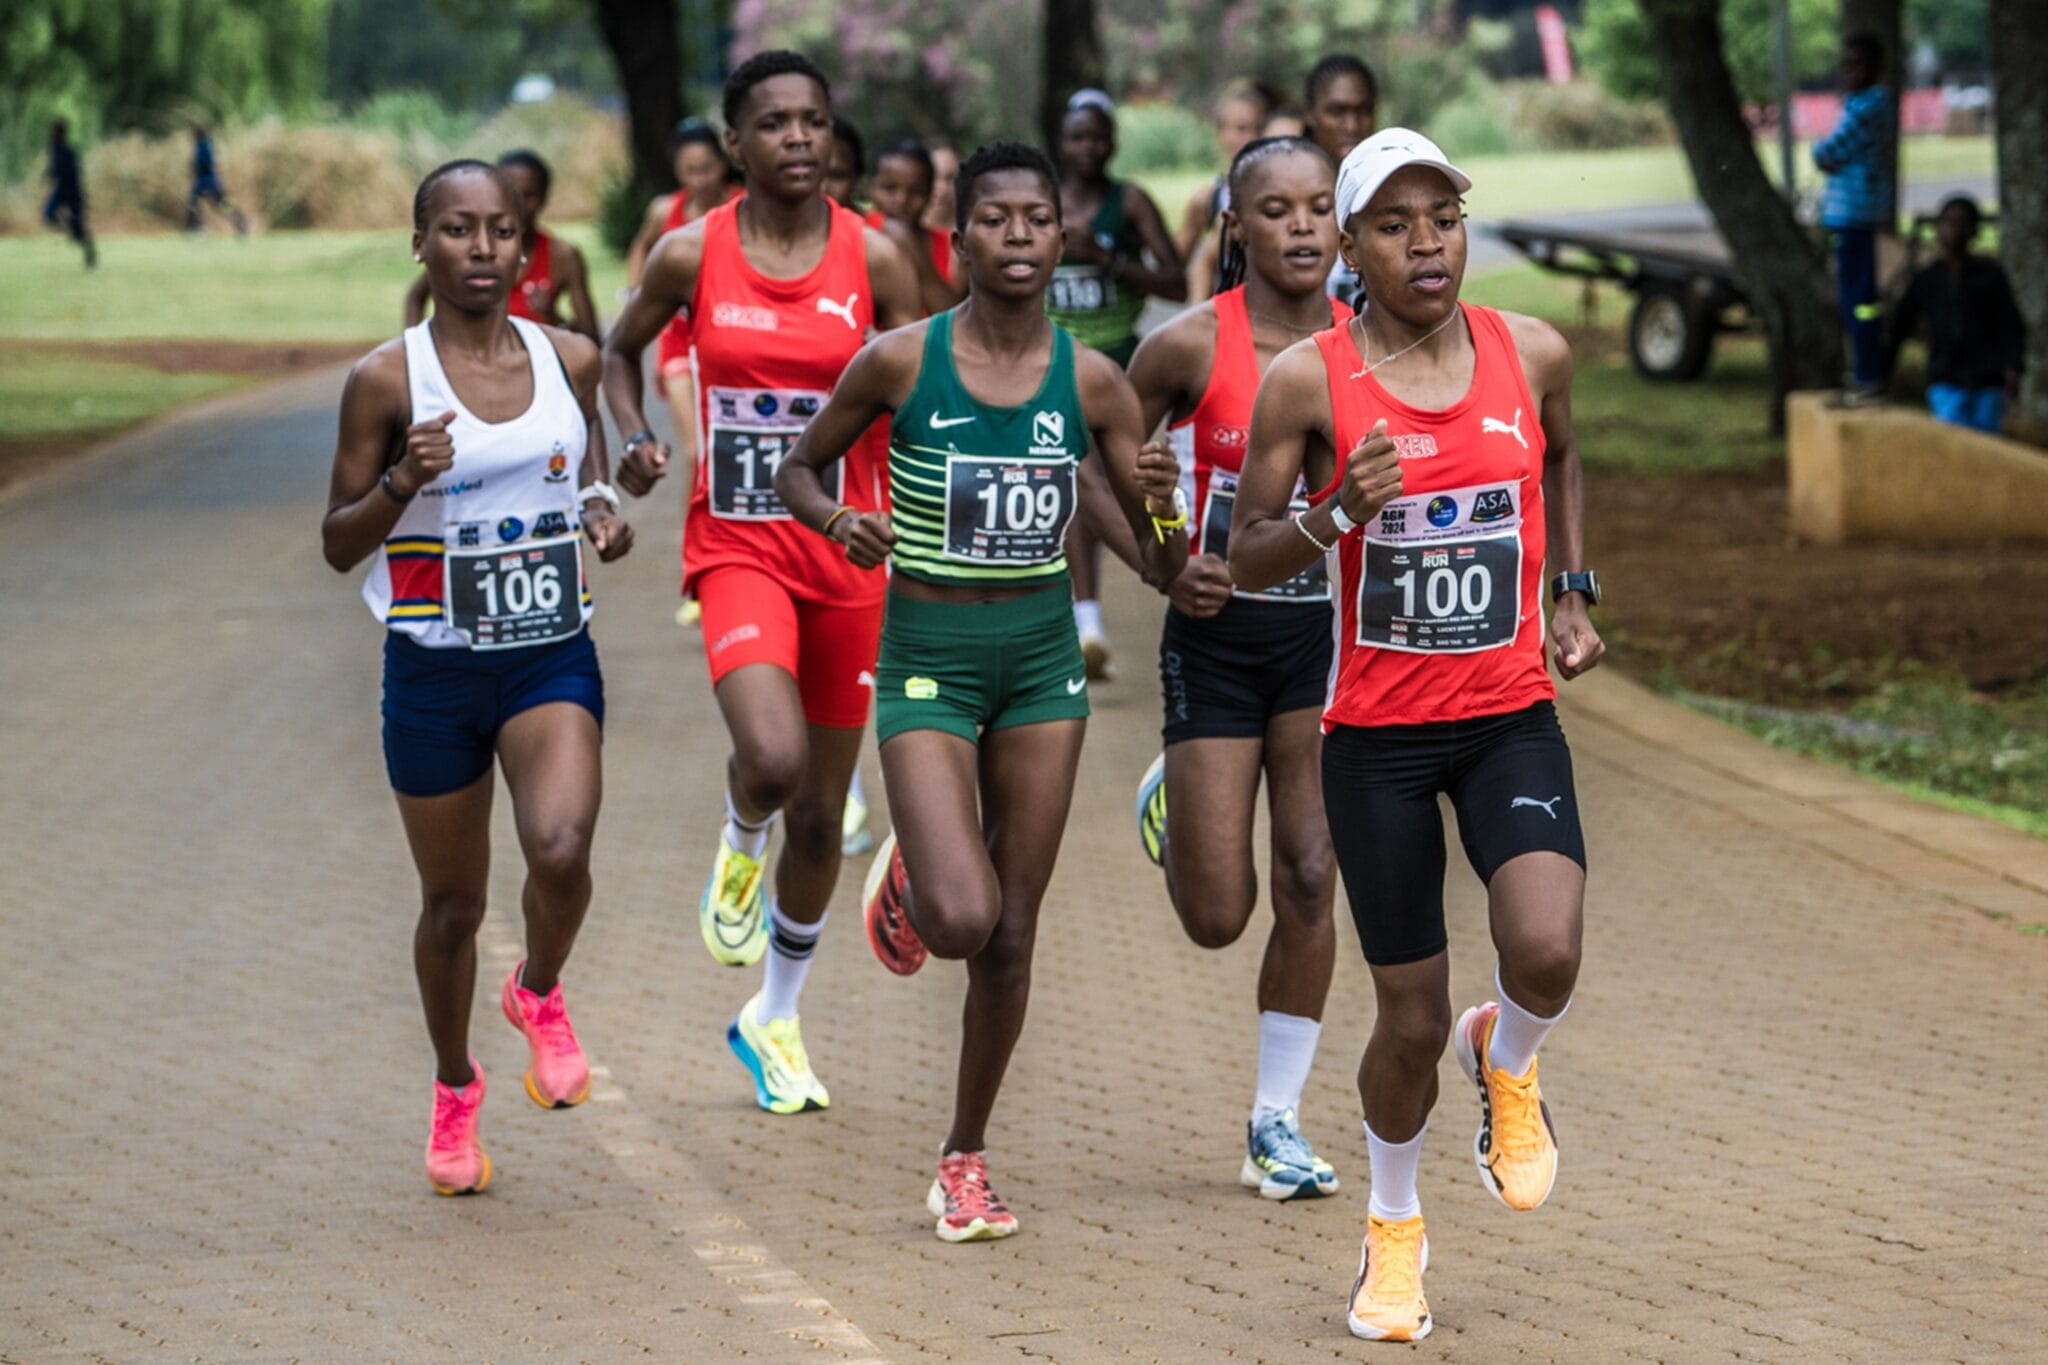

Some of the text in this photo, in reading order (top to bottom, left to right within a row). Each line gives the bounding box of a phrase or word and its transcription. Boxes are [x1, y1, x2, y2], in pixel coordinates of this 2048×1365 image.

[977, 483, 1060, 530] 109
[1476, 492, 1510, 512] ASA
[1422, 553, 1448, 568] RUN
[476, 564, 562, 616] 106
[1393, 564, 1492, 617] 100
